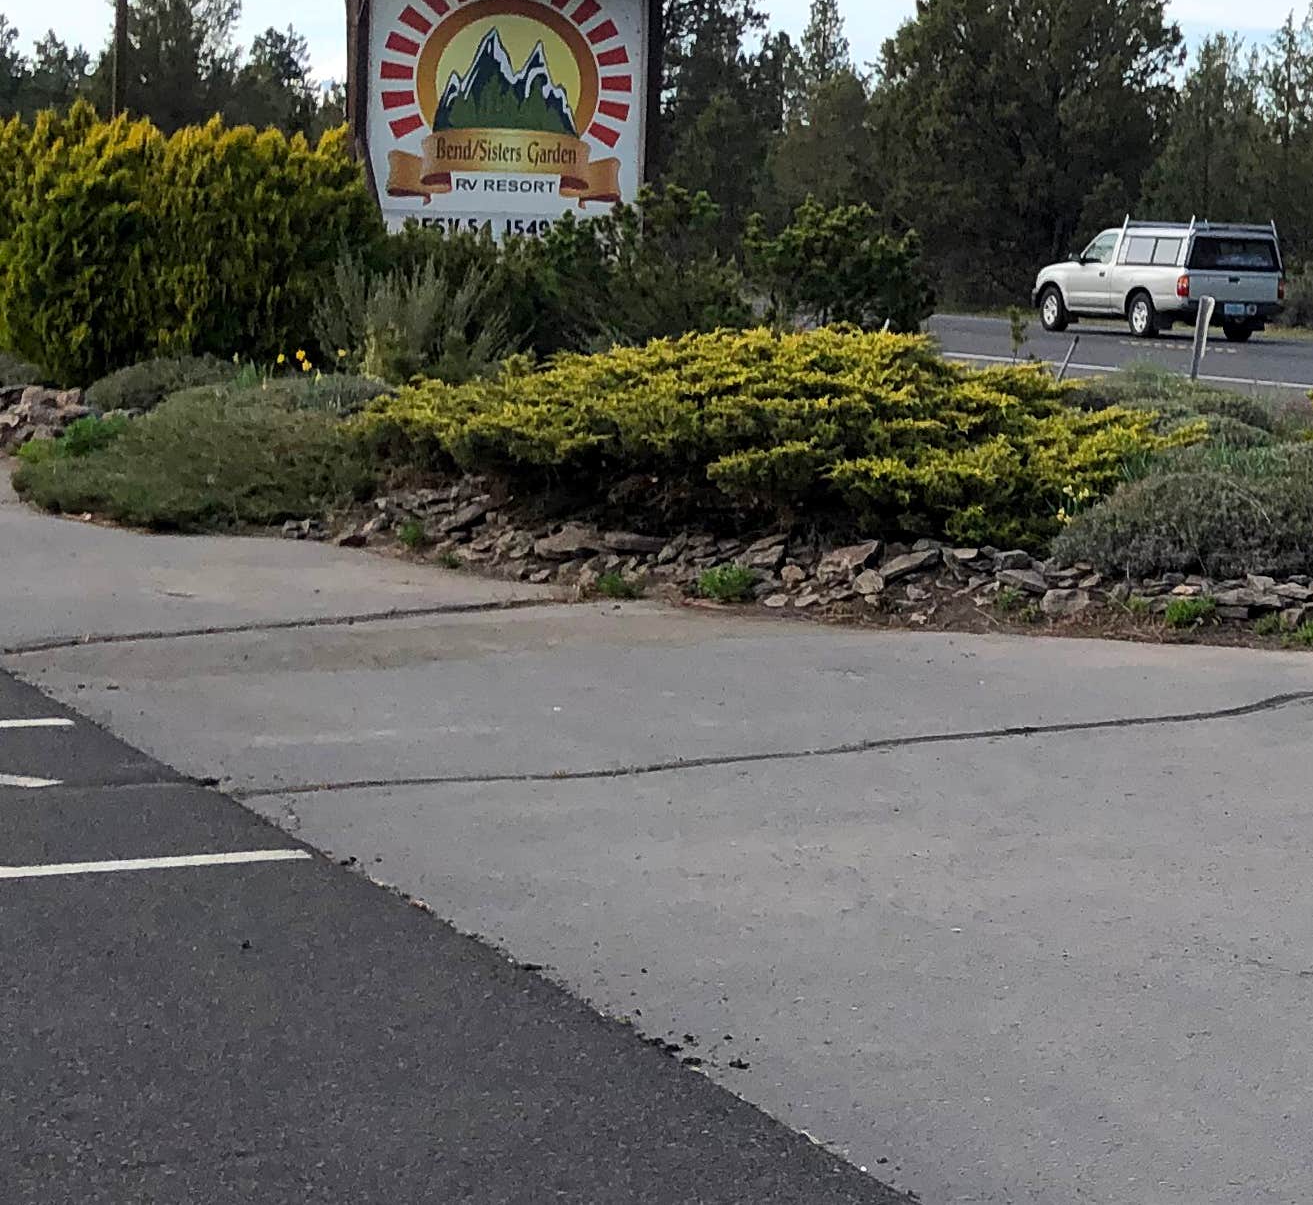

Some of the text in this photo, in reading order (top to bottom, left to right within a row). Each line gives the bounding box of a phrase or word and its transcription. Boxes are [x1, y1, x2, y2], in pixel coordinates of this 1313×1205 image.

[436, 137, 577, 167] Bend/Sisters Garden
[455, 178, 556, 193] RV RESORT
